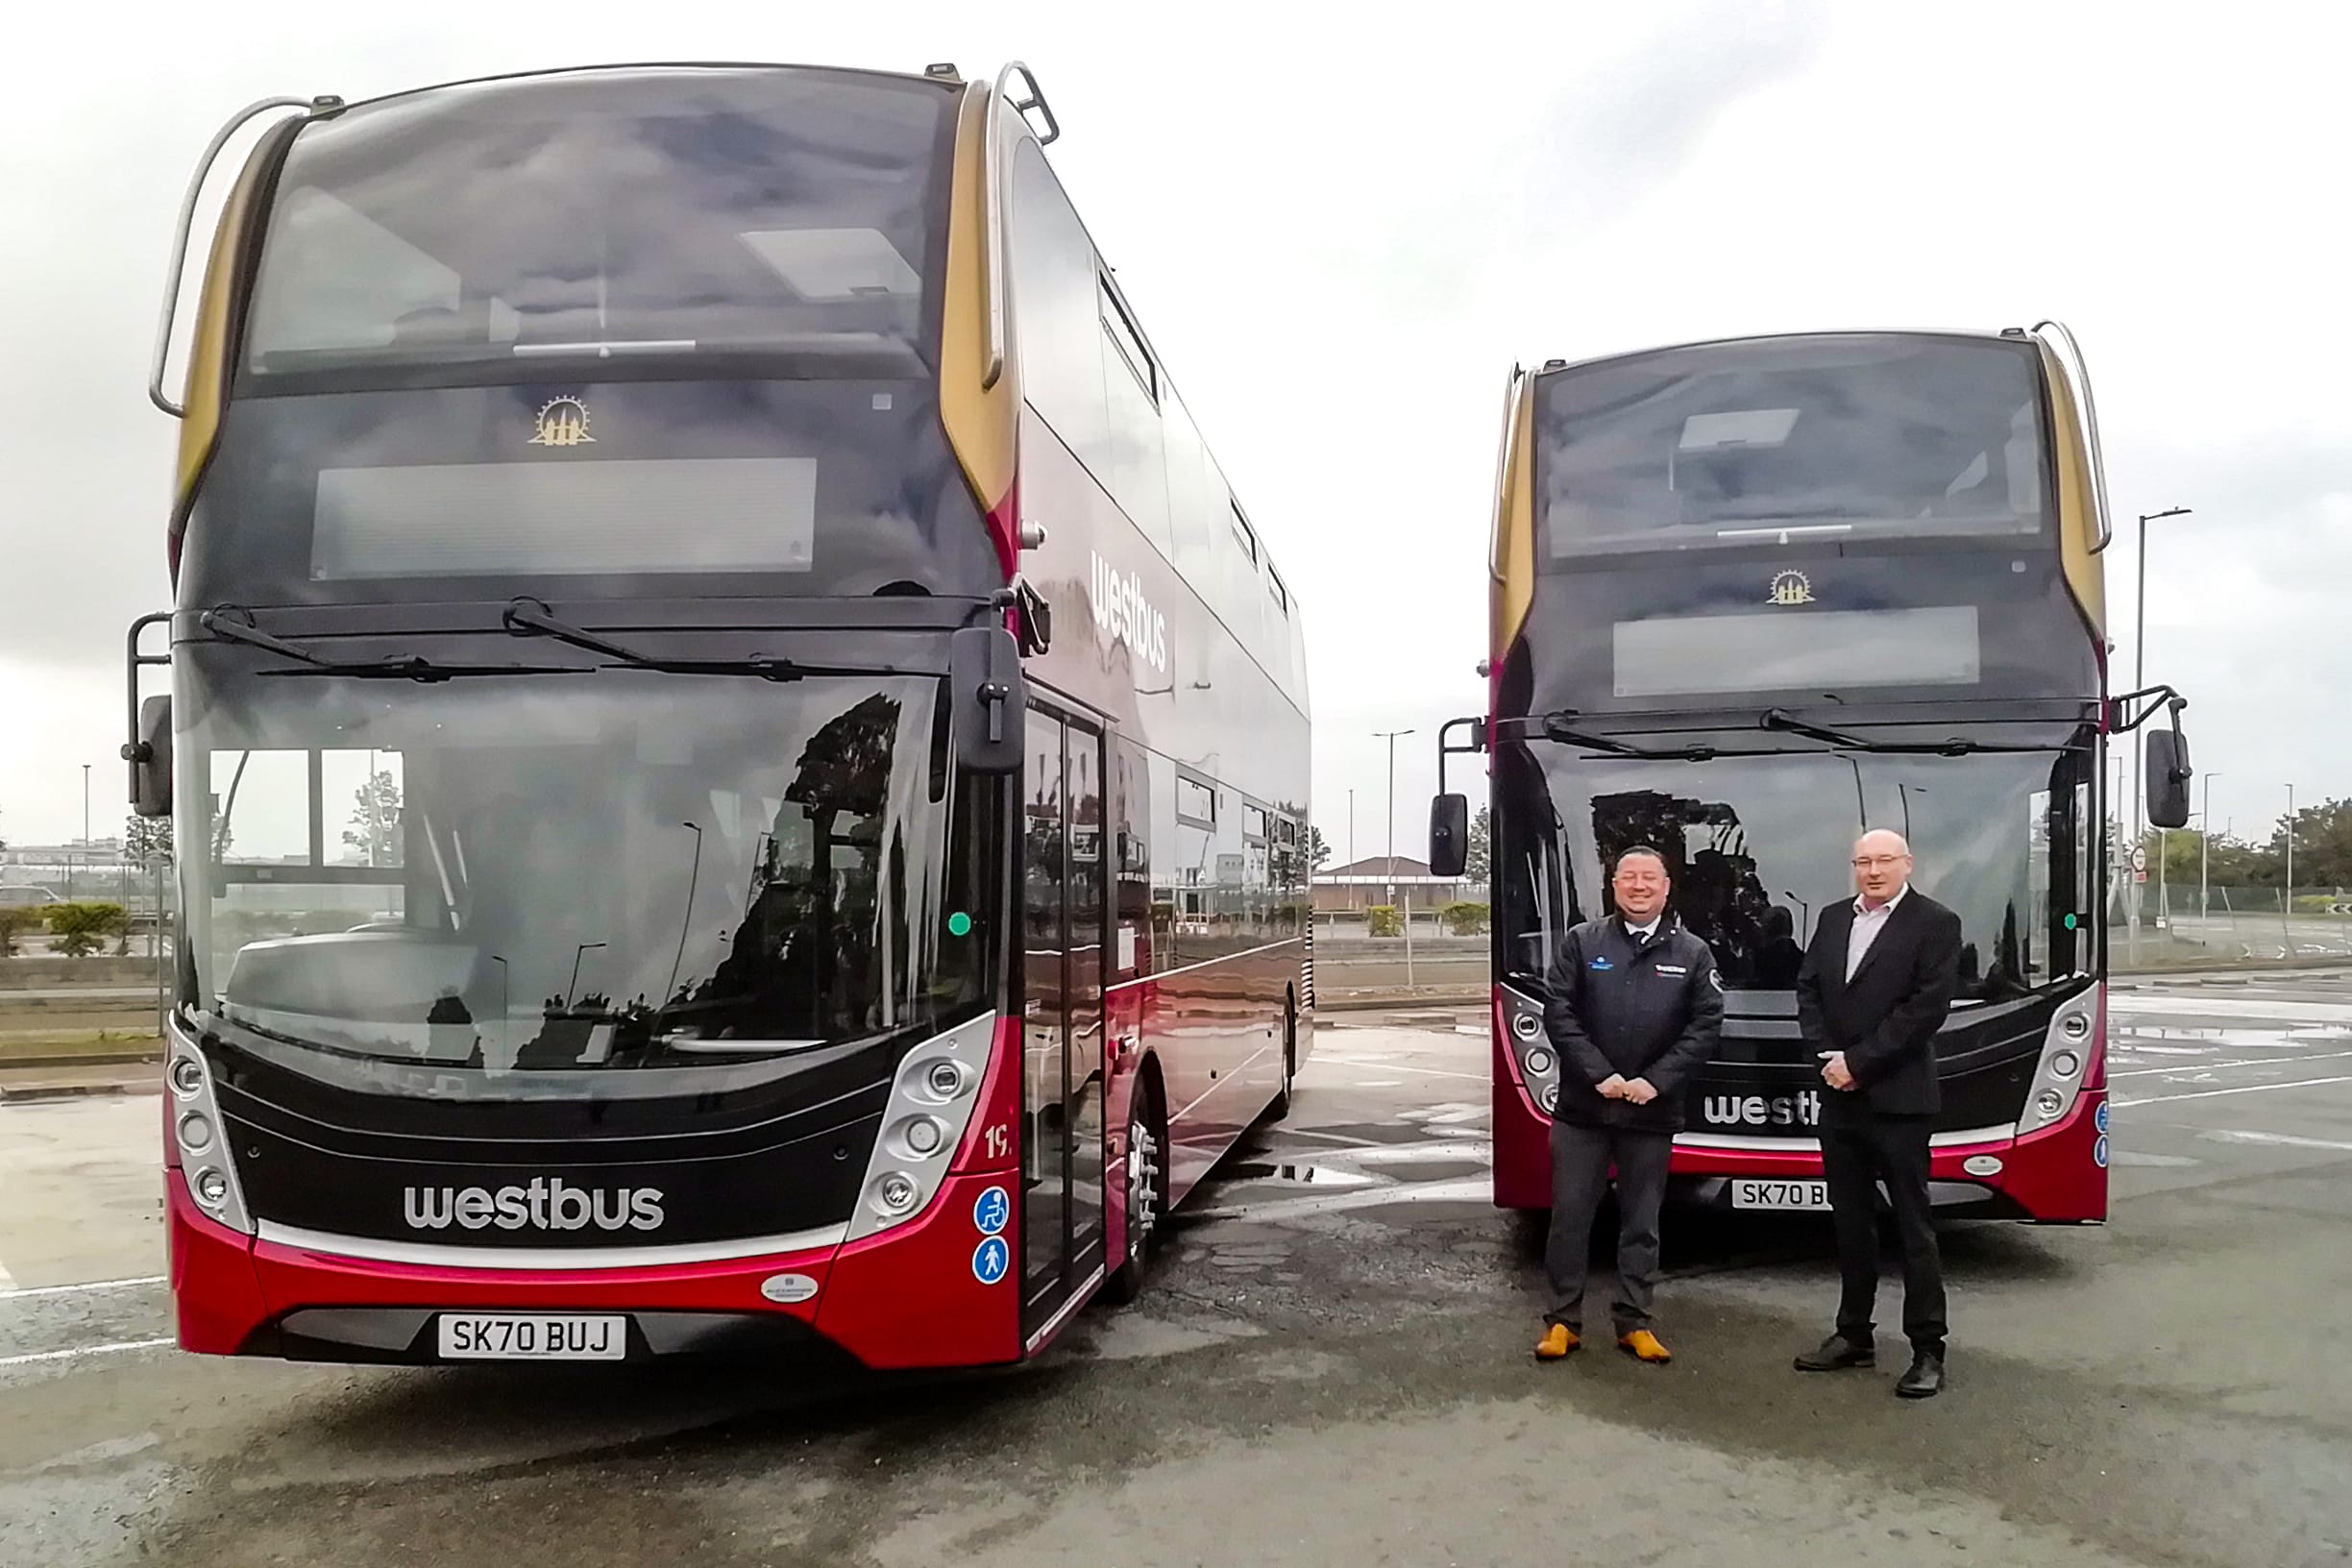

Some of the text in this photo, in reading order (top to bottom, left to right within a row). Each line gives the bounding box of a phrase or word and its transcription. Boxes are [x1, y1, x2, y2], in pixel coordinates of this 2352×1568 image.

[1090, 549, 1165, 674] westbus
[1703, 1090, 1823, 1126] west
[404, 1176, 665, 1230] westbus
[1743, 1183, 1803, 1205] SK70
[453, 1321, 609, 1352] SK70 BUJ
